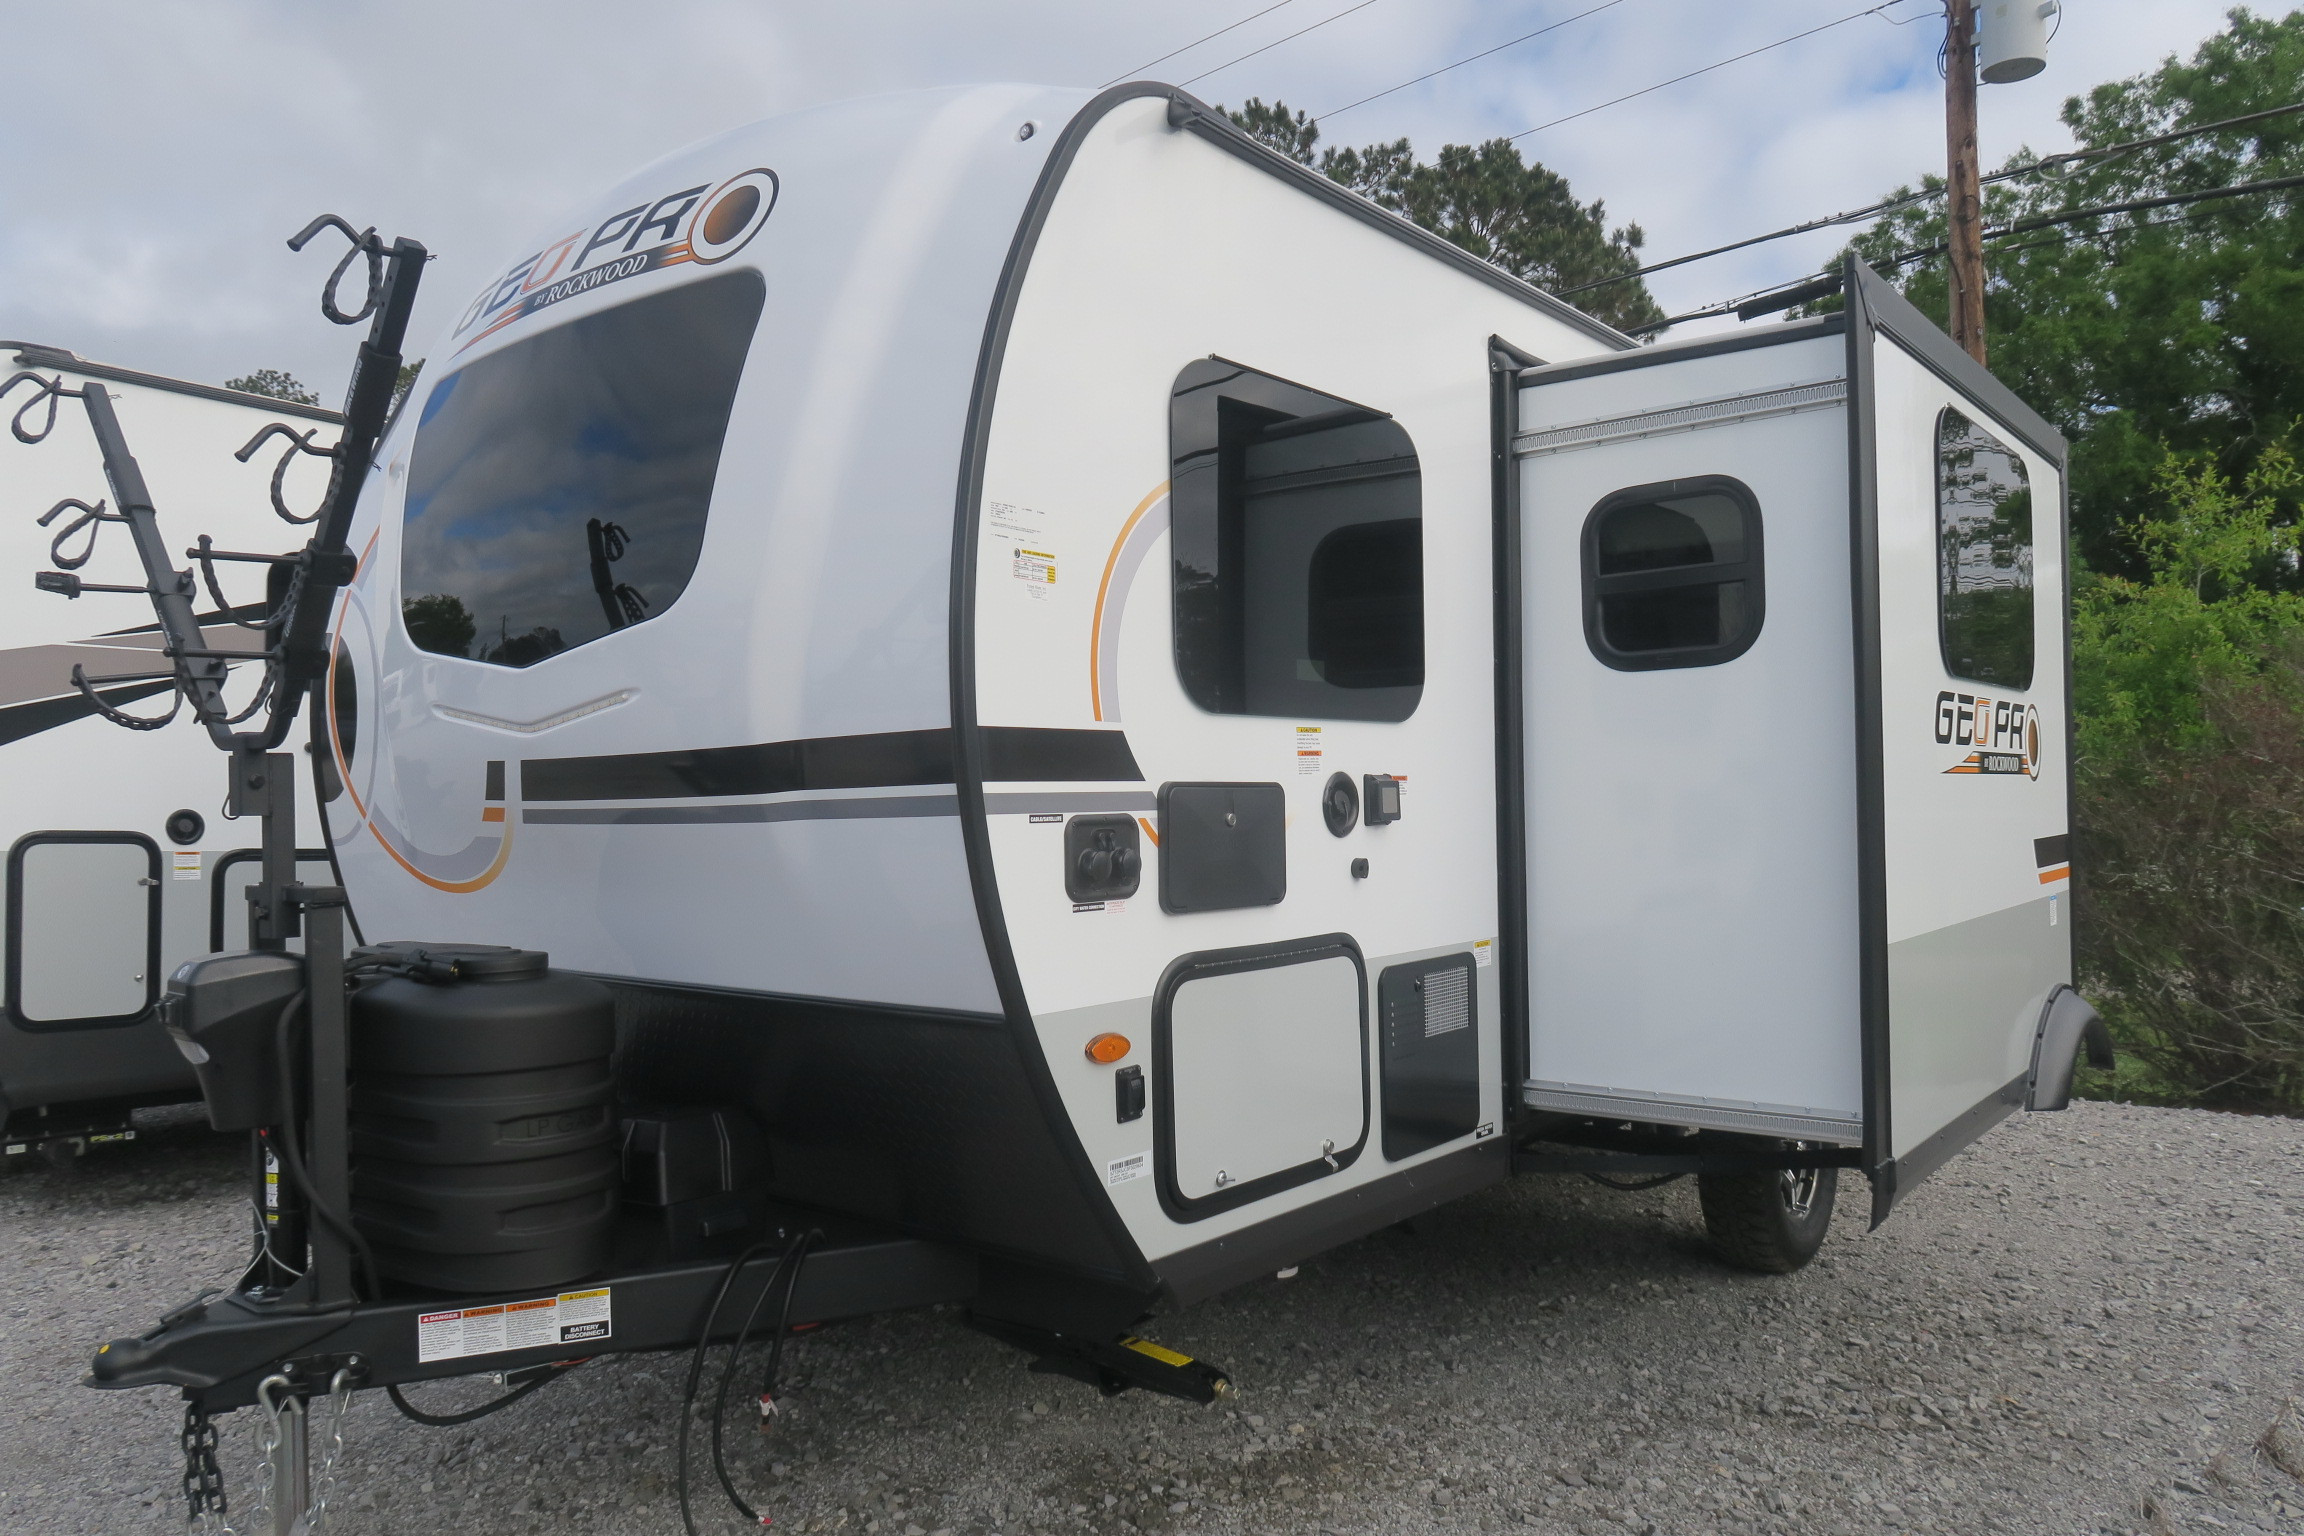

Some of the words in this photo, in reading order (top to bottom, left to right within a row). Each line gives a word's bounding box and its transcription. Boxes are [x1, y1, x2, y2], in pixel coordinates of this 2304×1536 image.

[452, 227, 589, 341] GEO
[570, 167, 780, 272] PRO
[534, 292, 549, 306] BY
[545, 254, 648, 305] ROCKWOOD
[1935, 690, 1991, 746] GEO
[1994, 700, 2041, 782] PRO
[1989, 756, 2019, 772] ROCKWOOD
[527, 1119, 549, 1138] LP
[574, 1291, 598, 1300] CAUTION
[469, 1306, 503, 1316] WARNING
[517, 1301, 550, 1310] WARNING
[429, 1312, 459, 1322] DANGER
[564, 1328, 606, 1340] DISCONNECT
[570, 1323, 600, 1333] BATTERY
